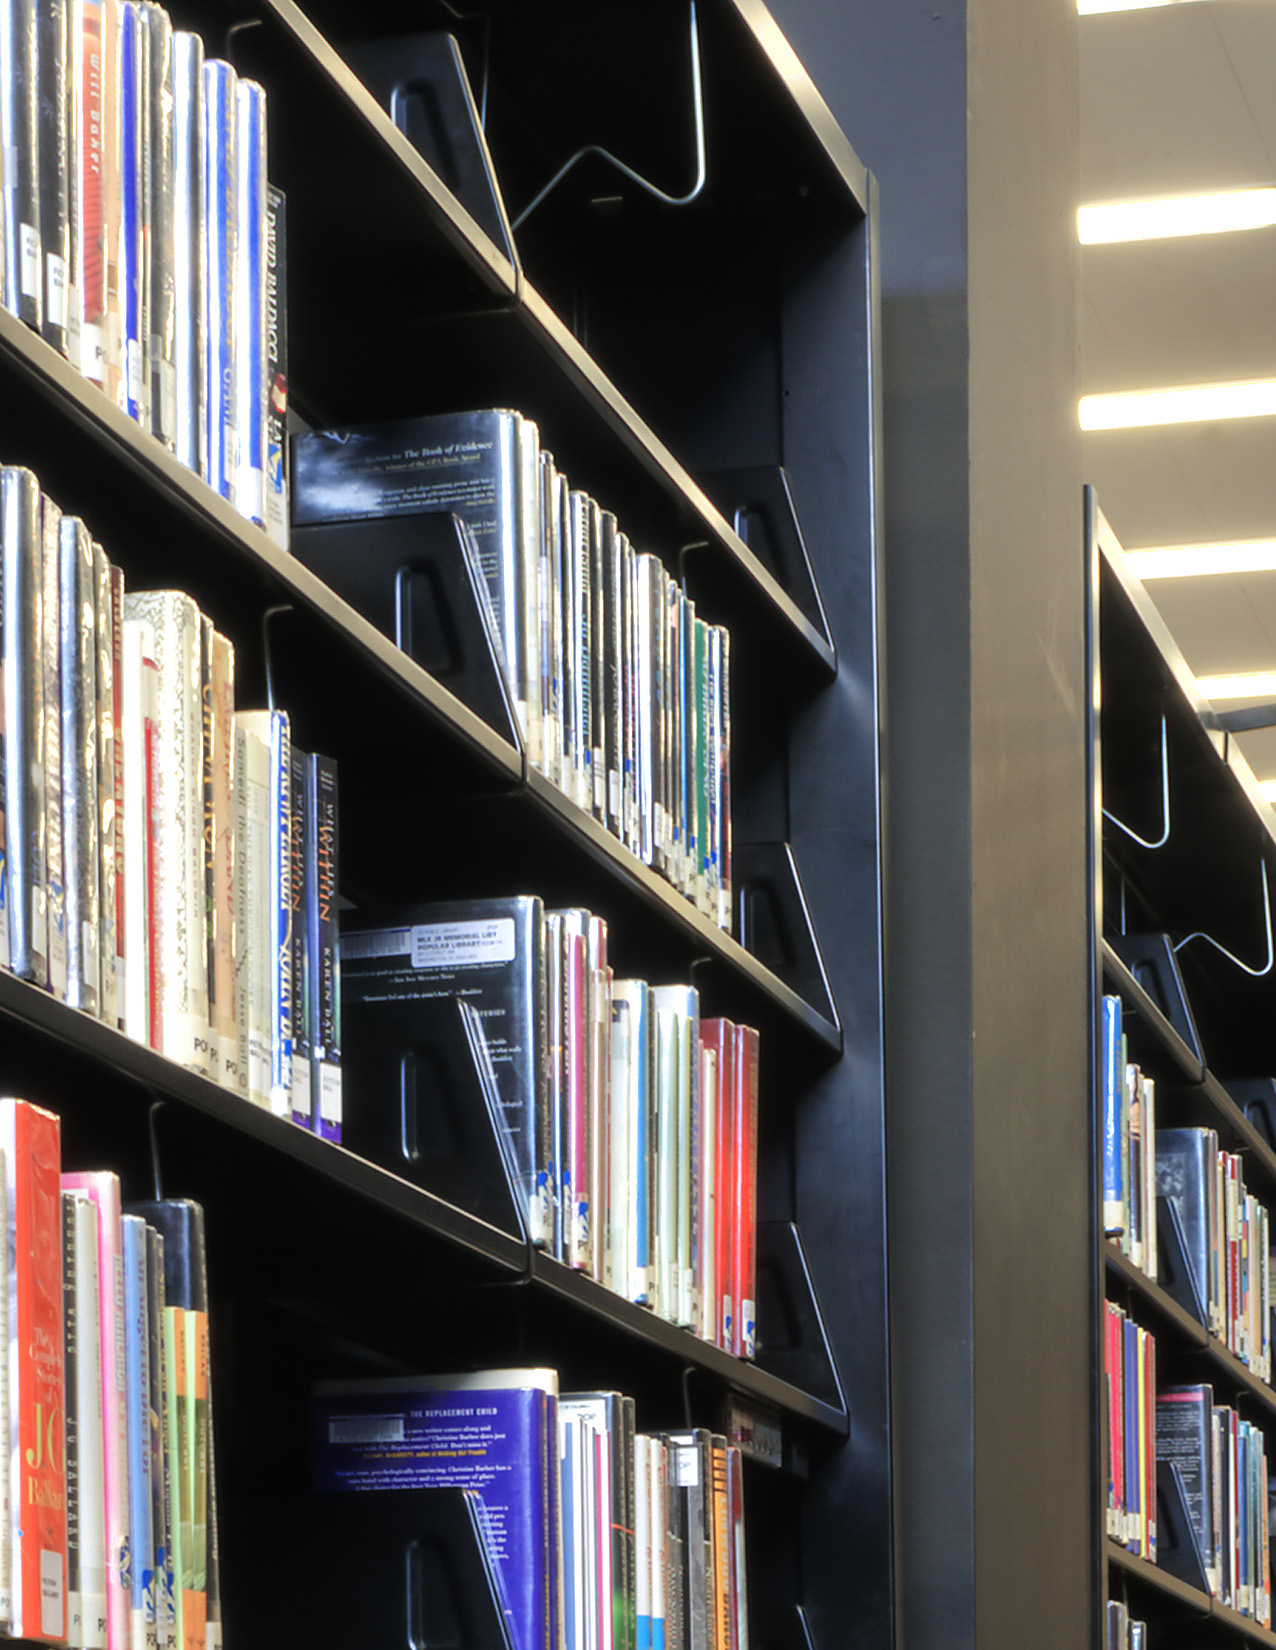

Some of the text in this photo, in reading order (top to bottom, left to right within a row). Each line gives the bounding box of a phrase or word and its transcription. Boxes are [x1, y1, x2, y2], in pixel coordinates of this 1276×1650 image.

[267, 211, 279, 363] DAVID BALDACCI
[417, 940, 481, 951] POPULAR LIBRARY
[425, 1408, 475, 1418] REPLACEMENT
[475, 1407, 499, 1416] CHILD
